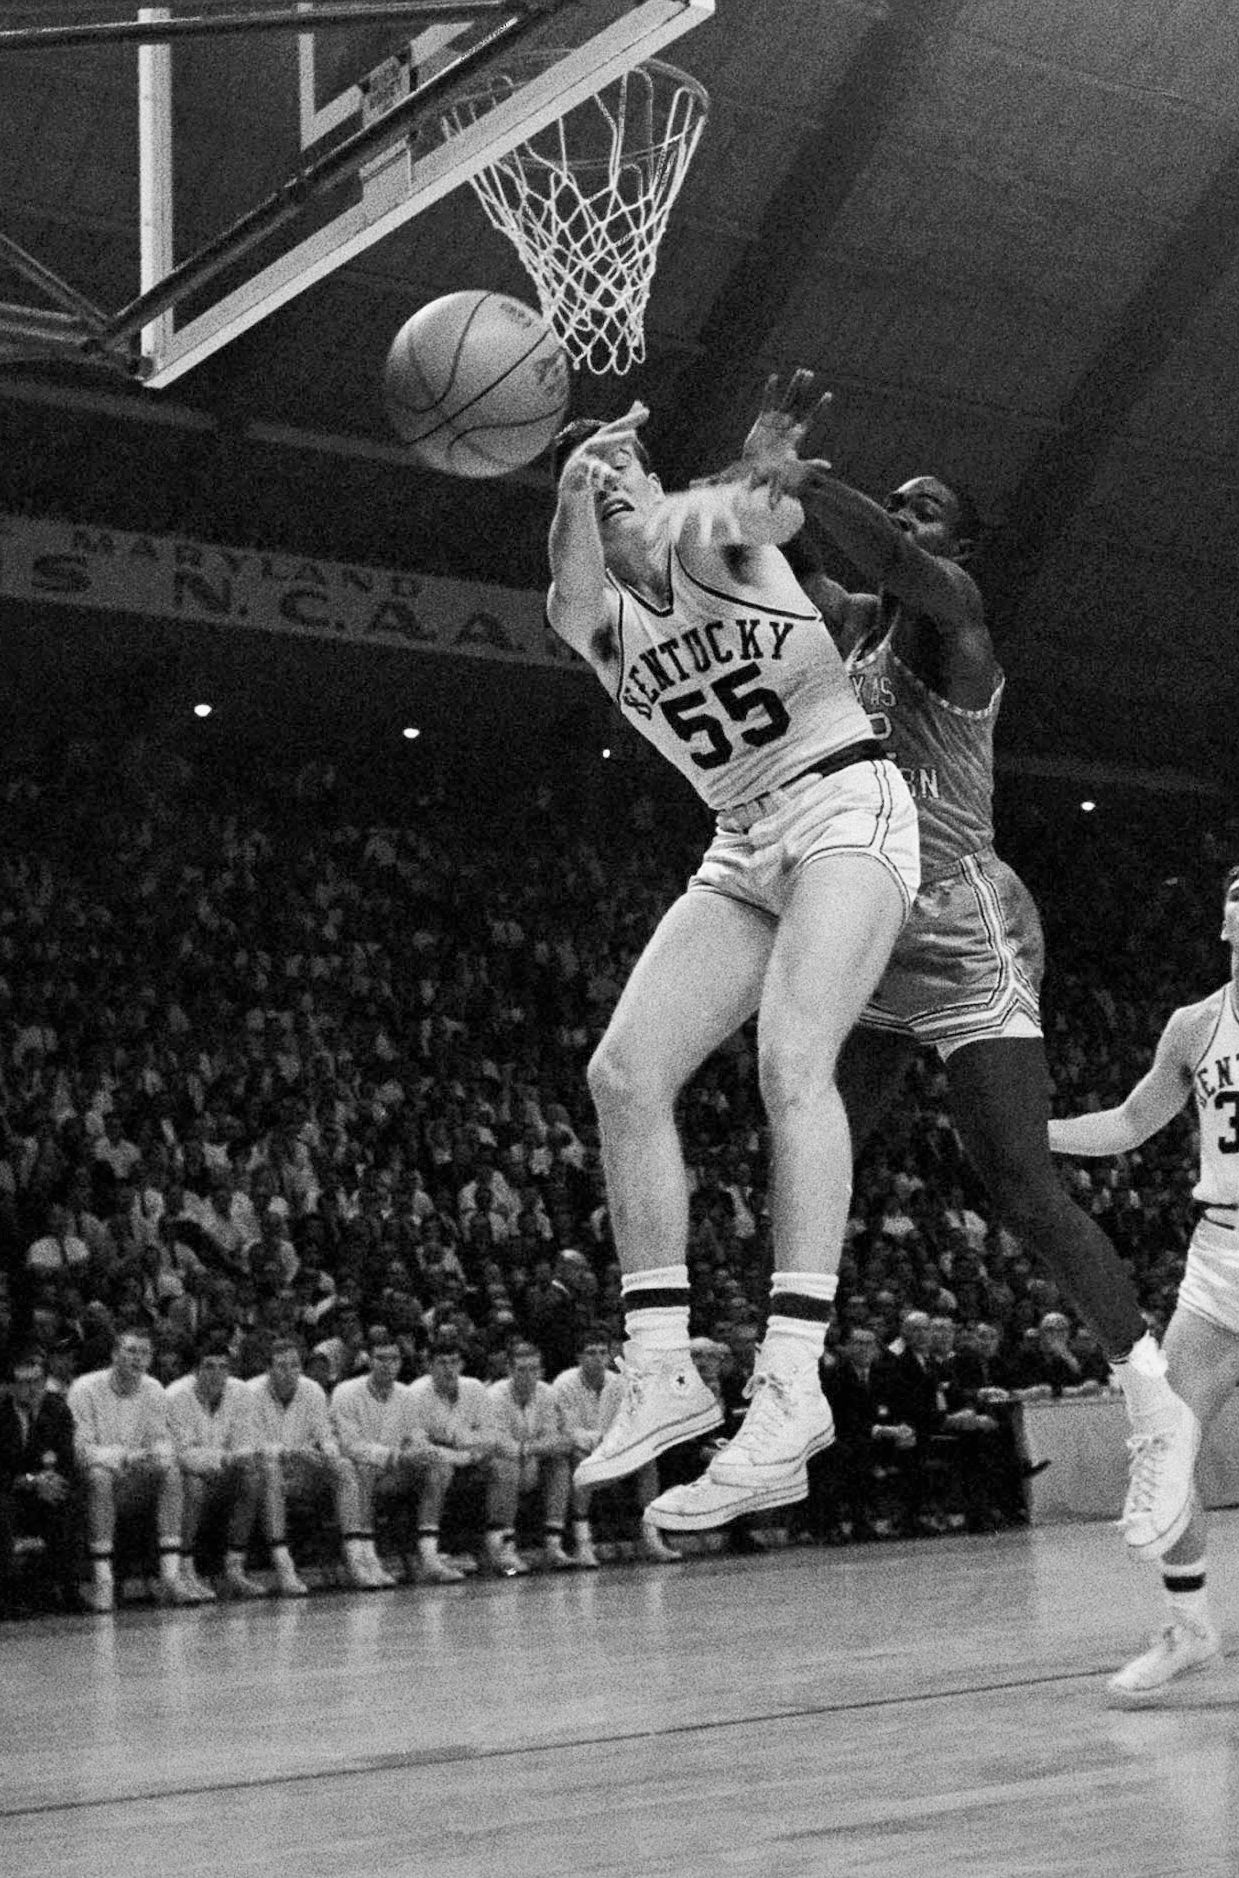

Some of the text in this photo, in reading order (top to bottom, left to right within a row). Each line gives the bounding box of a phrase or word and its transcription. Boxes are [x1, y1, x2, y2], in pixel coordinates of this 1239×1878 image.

[72, 530, 422, 597] MARYLAND
[622, 619, 794, 721] KENTUCKY
[658, 662, 792, 770] 55
